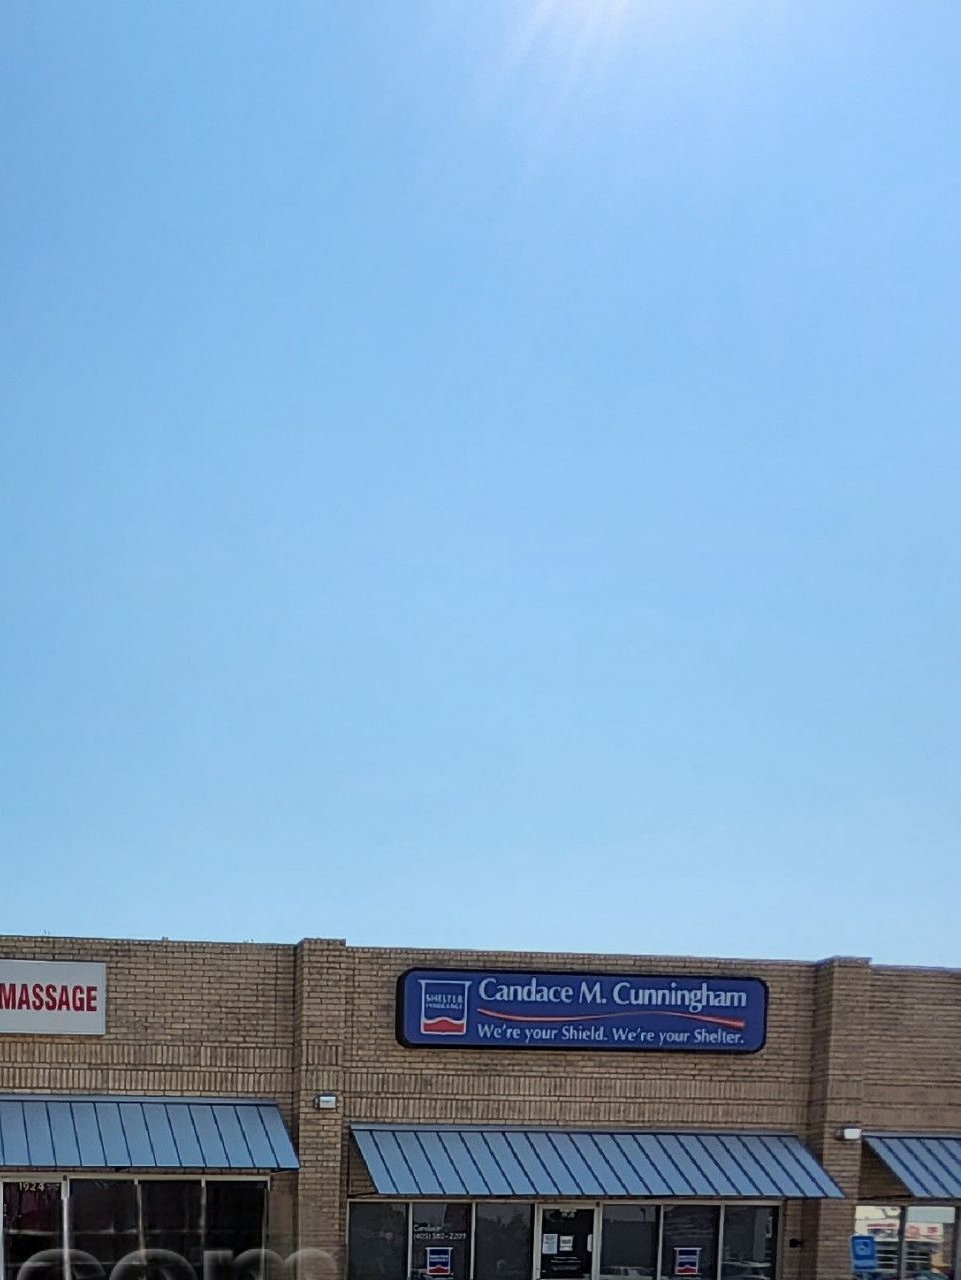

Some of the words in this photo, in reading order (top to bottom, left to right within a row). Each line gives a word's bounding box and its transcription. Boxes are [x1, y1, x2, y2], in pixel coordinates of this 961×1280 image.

[478, 977, 573, 1003] Candace
[579, 981, 607, 1004] M.
[613, 981, 747, 1013] Cunningham
[477, 1023, 520, 1039] We're
[524, 1027, 558, 1044] your
[561, 1024, 607, 1041] Shield.
[612, 1027, 655, 1042] We're
[659, 1031, 690, 1046] your
[694, 1029, 745, 1045] Shelter.
